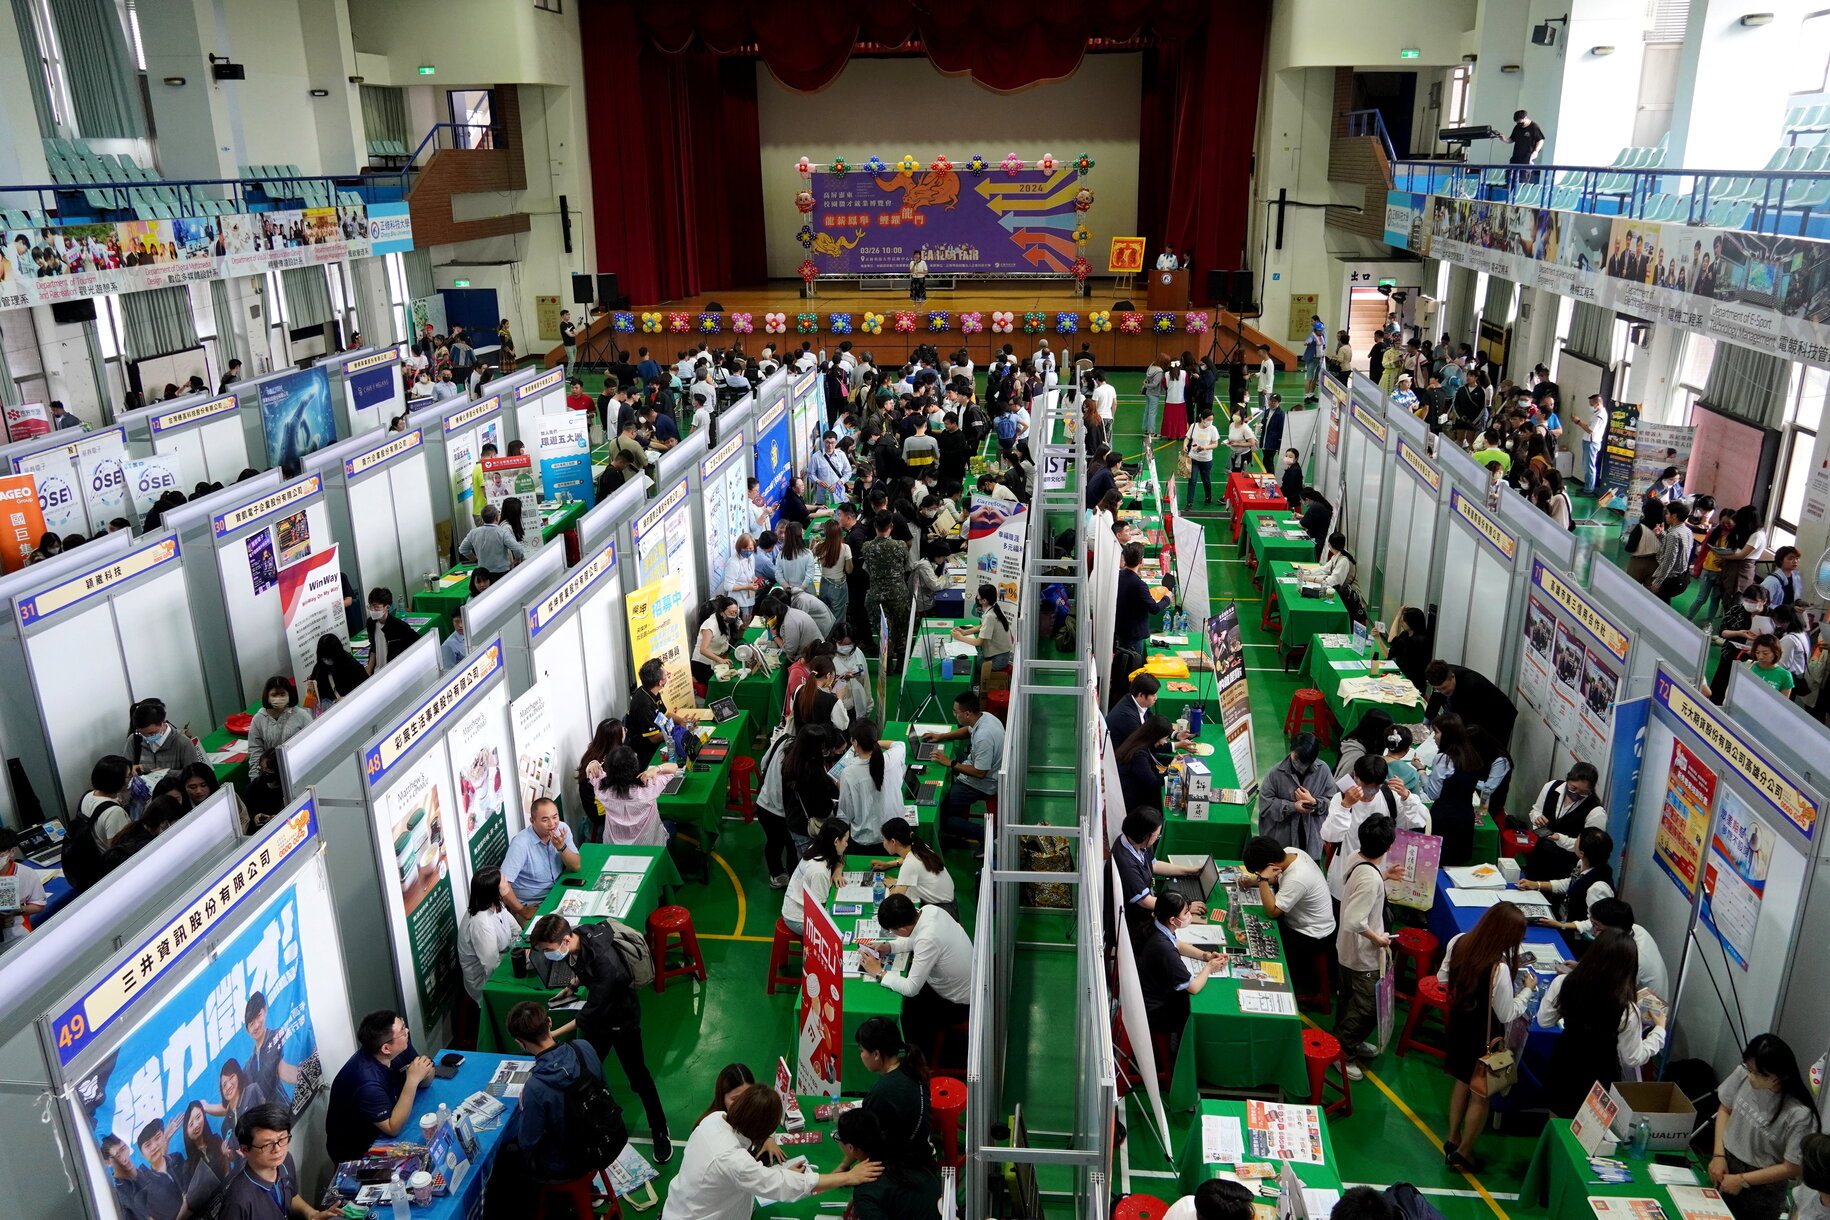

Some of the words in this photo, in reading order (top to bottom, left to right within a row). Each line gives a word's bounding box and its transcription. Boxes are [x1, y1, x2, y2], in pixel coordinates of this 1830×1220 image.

[1019, 184, 1044, 193] 2024
[860, 246, 880, 255] 03/26
[882, 246, 903, 254] 10:00
[959, 249, 979, 261] FAIR
[35, 279, 67, 291] Department
[75, 275, 98, 286] Tourism
[167, 268, 219, 284] 數位多媒體設計系
[38, 291, 48, 300] and
[49, 287, 78, 299] Recreation
[78, 281, 119, 296] 觀光遊憩系
[0, 293, 30, 307] 管理系
[1668, 307, 1704, 329] 電機工程系
[1711, 304, 1744, 322] Department
[1750, 314, 1772, 330] E-Sport
[1709, 319, 1737, 339] Technology
[1737, 326, 1778, 348] Management
[1779, 335, 1830, 363] 電競科技管
[152, 419, 160, 430] 12
[541, 432, 582, 447] 環遊五大洲
[93, 469, 122, 492] OSE
[138, 474, 171, 492] OSE
[38, 488, 69, 512] OSE
[214, 519, 225, 533] 30
[86, 566, 122, 590] 穎崴科技
[308, 572, 338, 592] WinWay
[1535, 565, 1543, 580] 71
[20, 603, 35, 620] 31
[651, 591, 682, 619] 招募中
[1550, 580, 1606, 638] 高雄市第三信用合作社
[530, 613, 539, 630] 47
[659, 645, 680, 662] 務專員
[1659, 679, 1669, 700] 72
[1680, 701, 1783, 801] 元大期貨股份有限公司高雄分公司
[367, 753, 381, 776] 48
[122, 849, 271, 994] 三井資訊股份有限公司
[805, 916, 836, 976] MACU
[58, 1014, 85, 1049] 49
